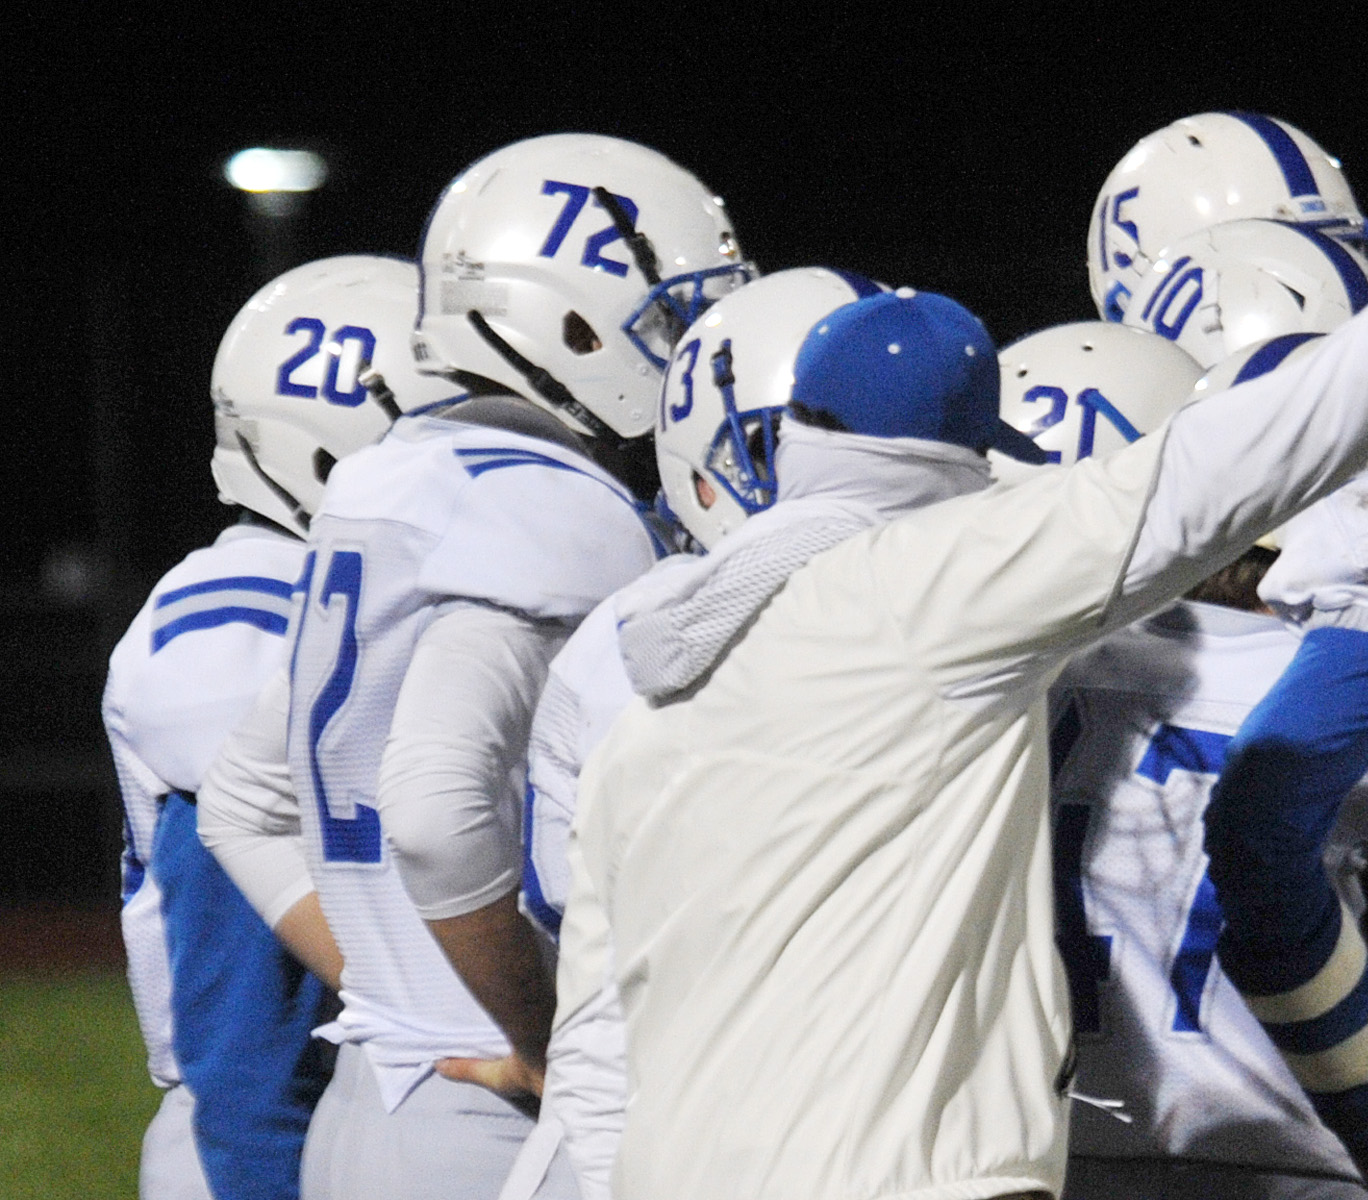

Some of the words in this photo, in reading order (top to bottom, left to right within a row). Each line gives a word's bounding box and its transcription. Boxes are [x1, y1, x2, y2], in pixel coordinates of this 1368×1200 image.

[538, 179, 640, 278] 72
[1141, 255, 1205, 342] 10
[275, 317, 376, 408] 20
[1022, 384, 1101, 464] 21
